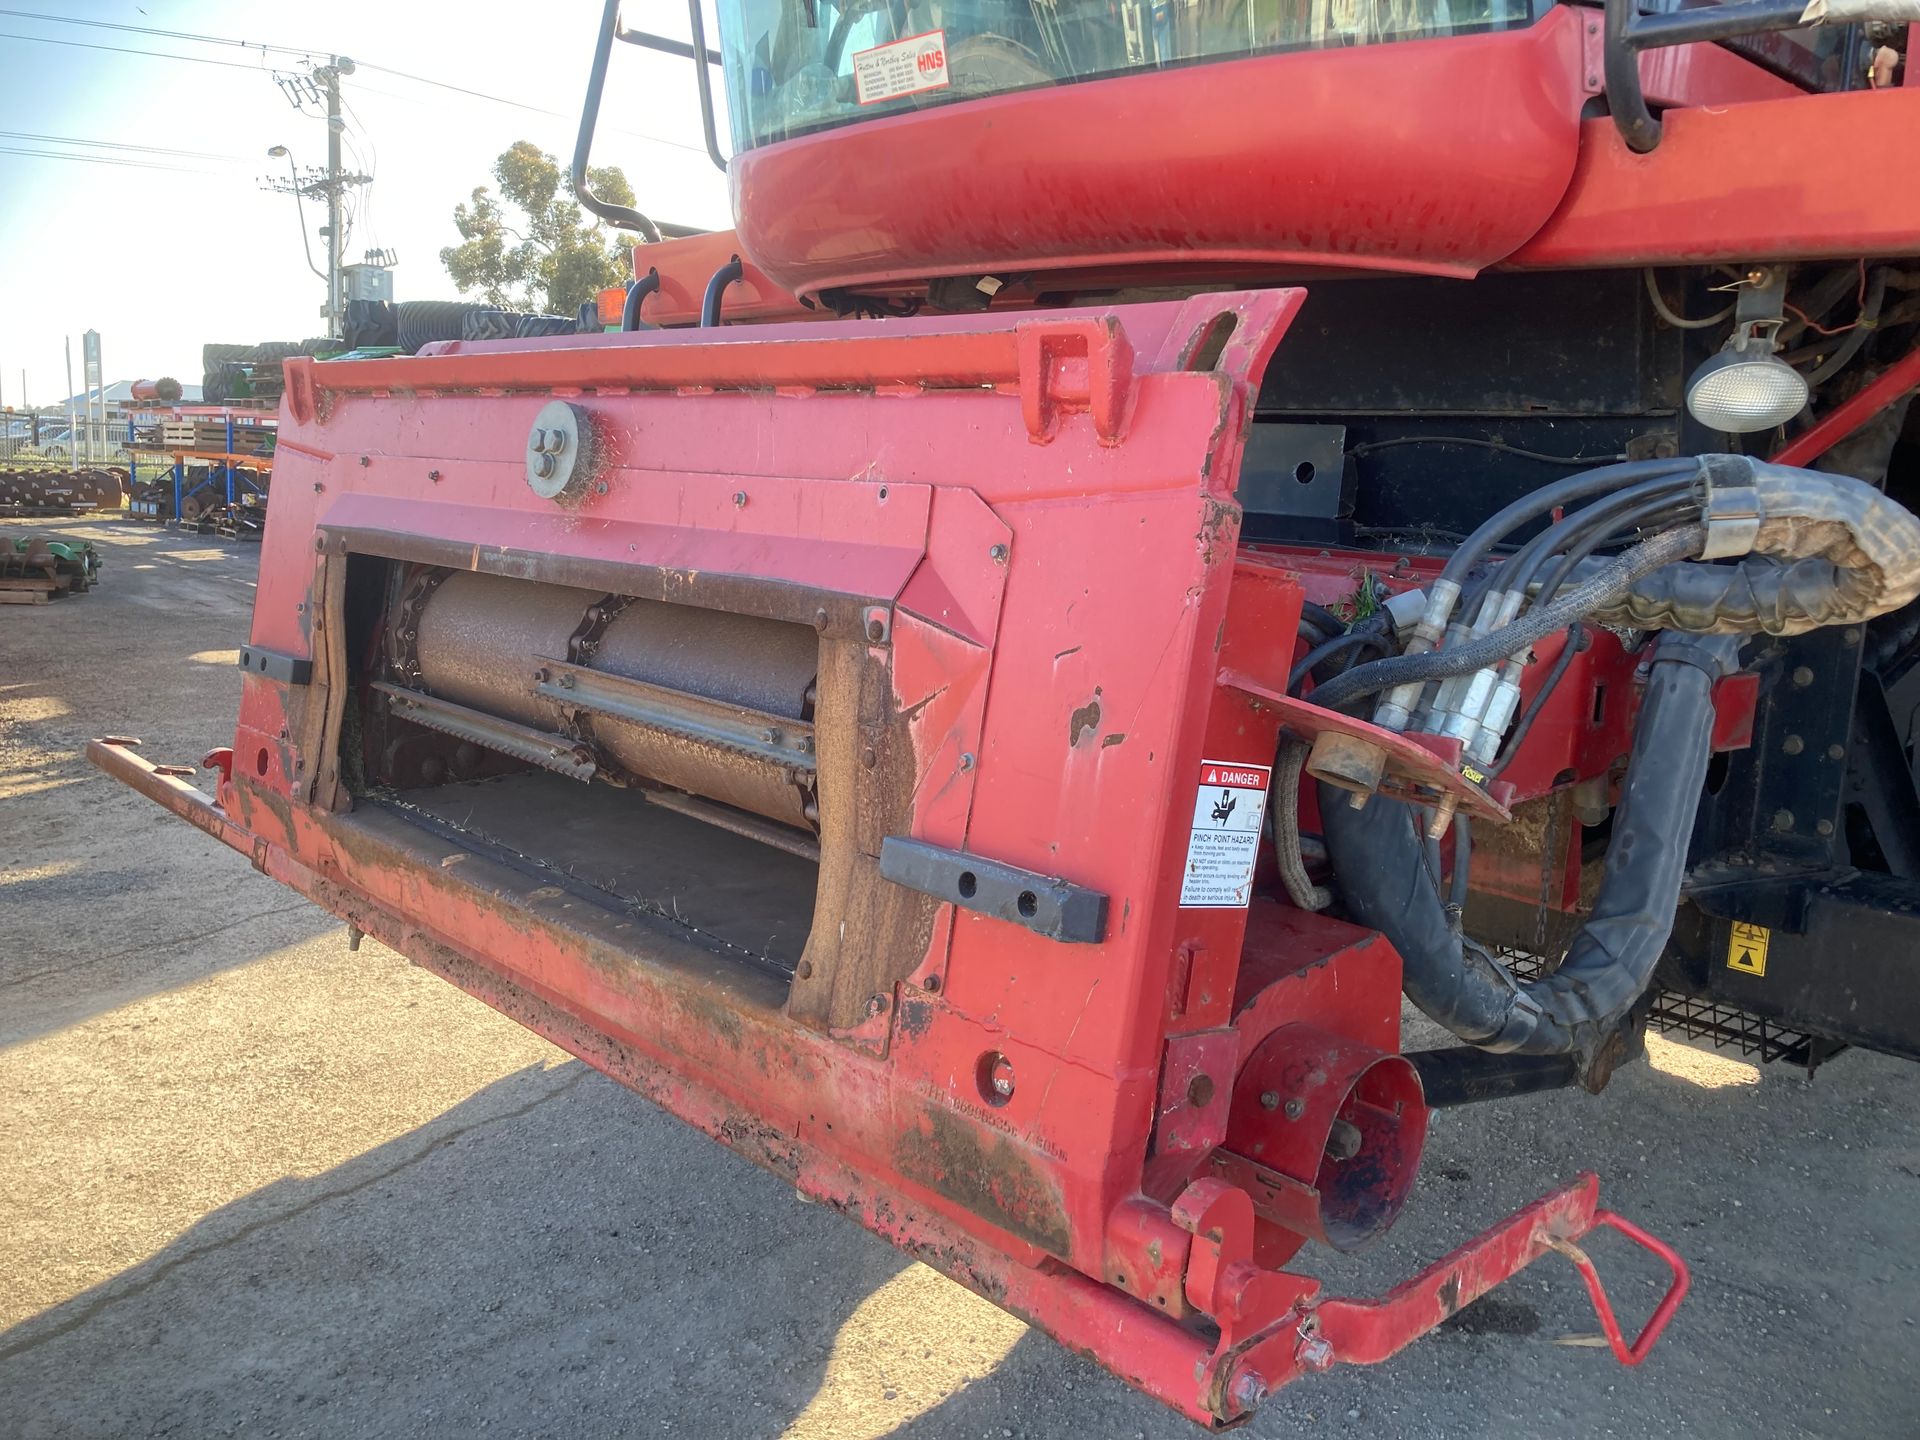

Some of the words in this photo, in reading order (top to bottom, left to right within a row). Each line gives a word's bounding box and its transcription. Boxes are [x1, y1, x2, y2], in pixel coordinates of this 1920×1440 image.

[917, 50, 944, 72] HNS
[1221, 771, 1260, 786] DANGER
[1193, 833, 1212, 842] PINCH
[1213, 834, 1231, 843] POINT
[1231, 835, 1255, 845] HAZARD
